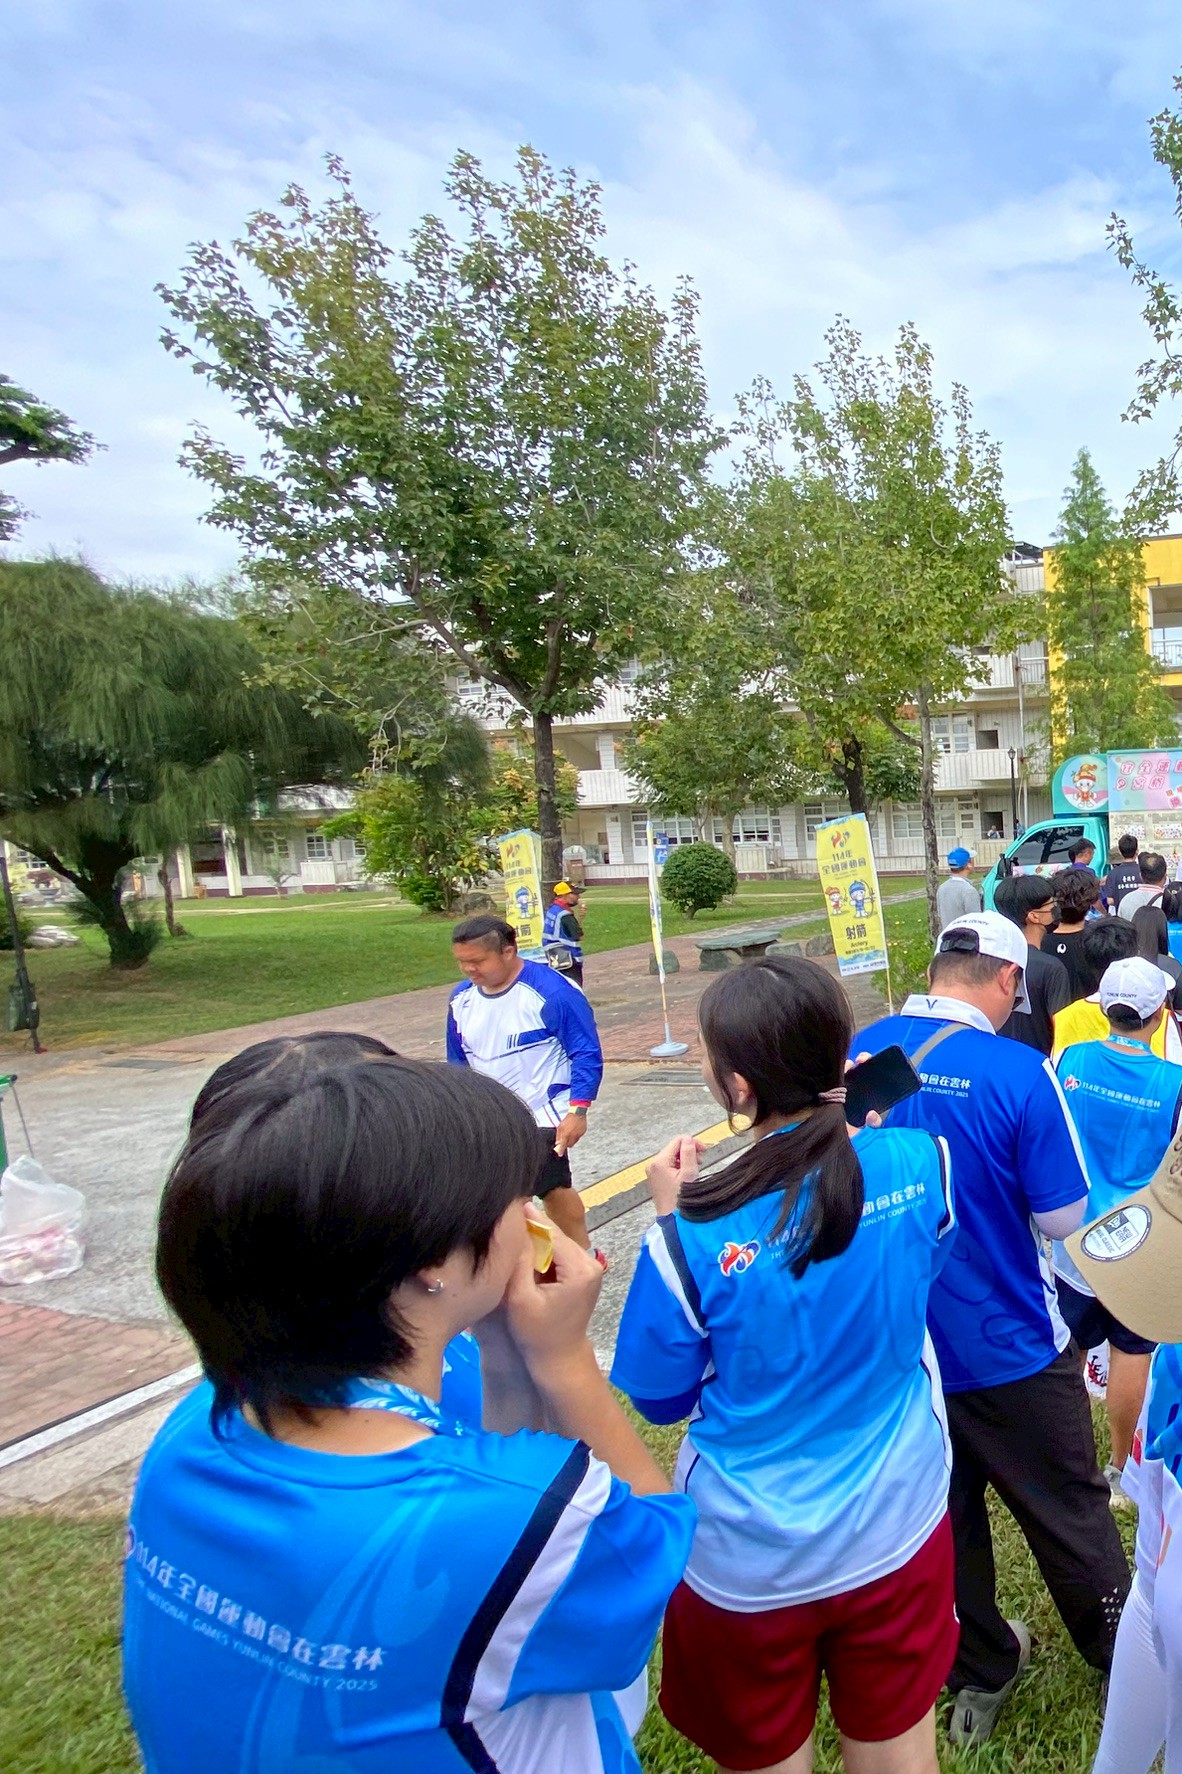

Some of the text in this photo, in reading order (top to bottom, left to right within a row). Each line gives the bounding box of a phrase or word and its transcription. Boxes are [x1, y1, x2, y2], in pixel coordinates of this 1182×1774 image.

[832, 850, 853, 861] 114年
[822, 857, 866, 875] 全國運動會
[846, 923, 867, 940] 射箭
[933, 1087, 955, 1096] COUNTY
[858, 1213, 886, 1229] YUNLIN
[887, 1205, 914, 1218] COUNTY
[1114, 1229, 1126, 1243] ERA
[1121, 1225, 1132, 1238] NEW
[135, 1540, 387, 1672] 114年全國運動會在雲林
[277, 1661, 331, 1690] COUNTY
[336, 1678, 378, 1692] 2025
